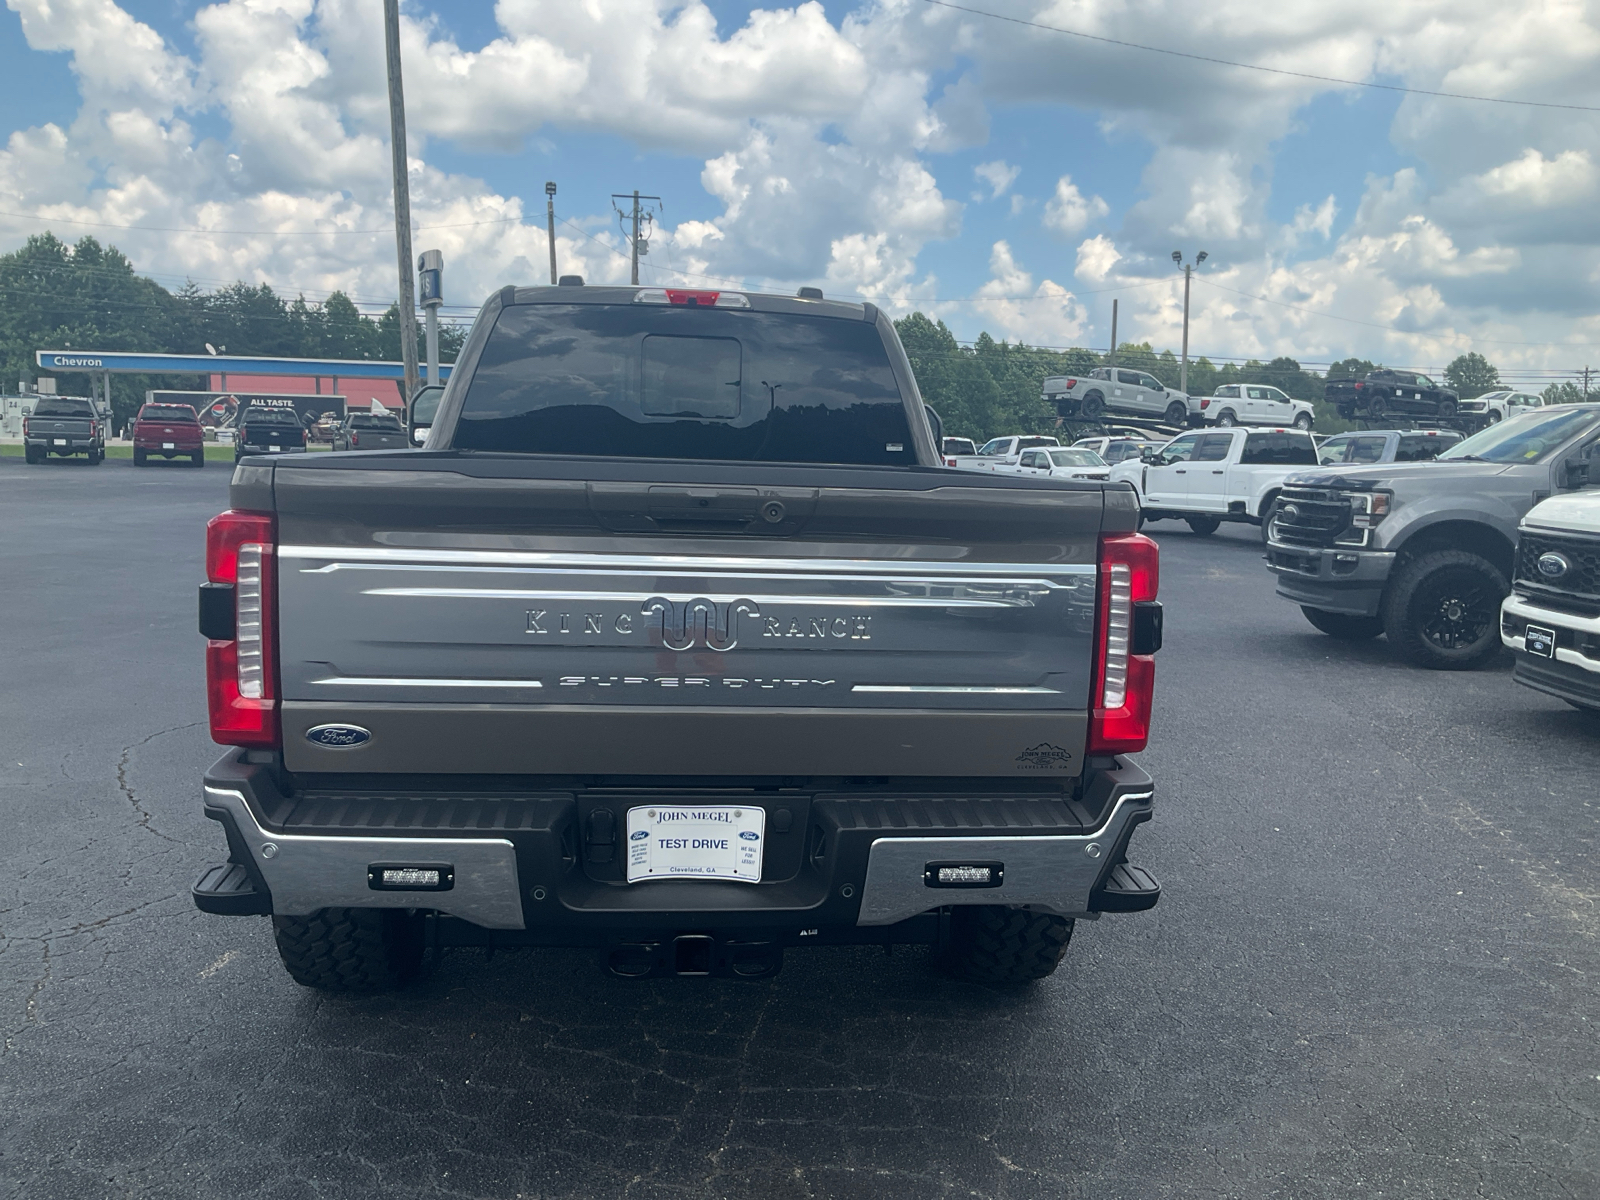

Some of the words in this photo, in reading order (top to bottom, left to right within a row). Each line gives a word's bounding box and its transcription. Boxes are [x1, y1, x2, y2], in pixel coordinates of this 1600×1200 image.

[54, 356, 102, 366] Chevron
[267, 399, 295, 407] TASTE.
[525, 608, 633, 635] KING
[763, 614, 872, 639] RANCH
[559, 676, 710, 688] SUPER
[722, 678, 836, 690] DUTY
[657, 812, 688, 824] JOHN
[691, 812, 732, 823] MEGEL
[658, 838, 689, 849] TEST
[692, 839, 729, 850] DRIVE
